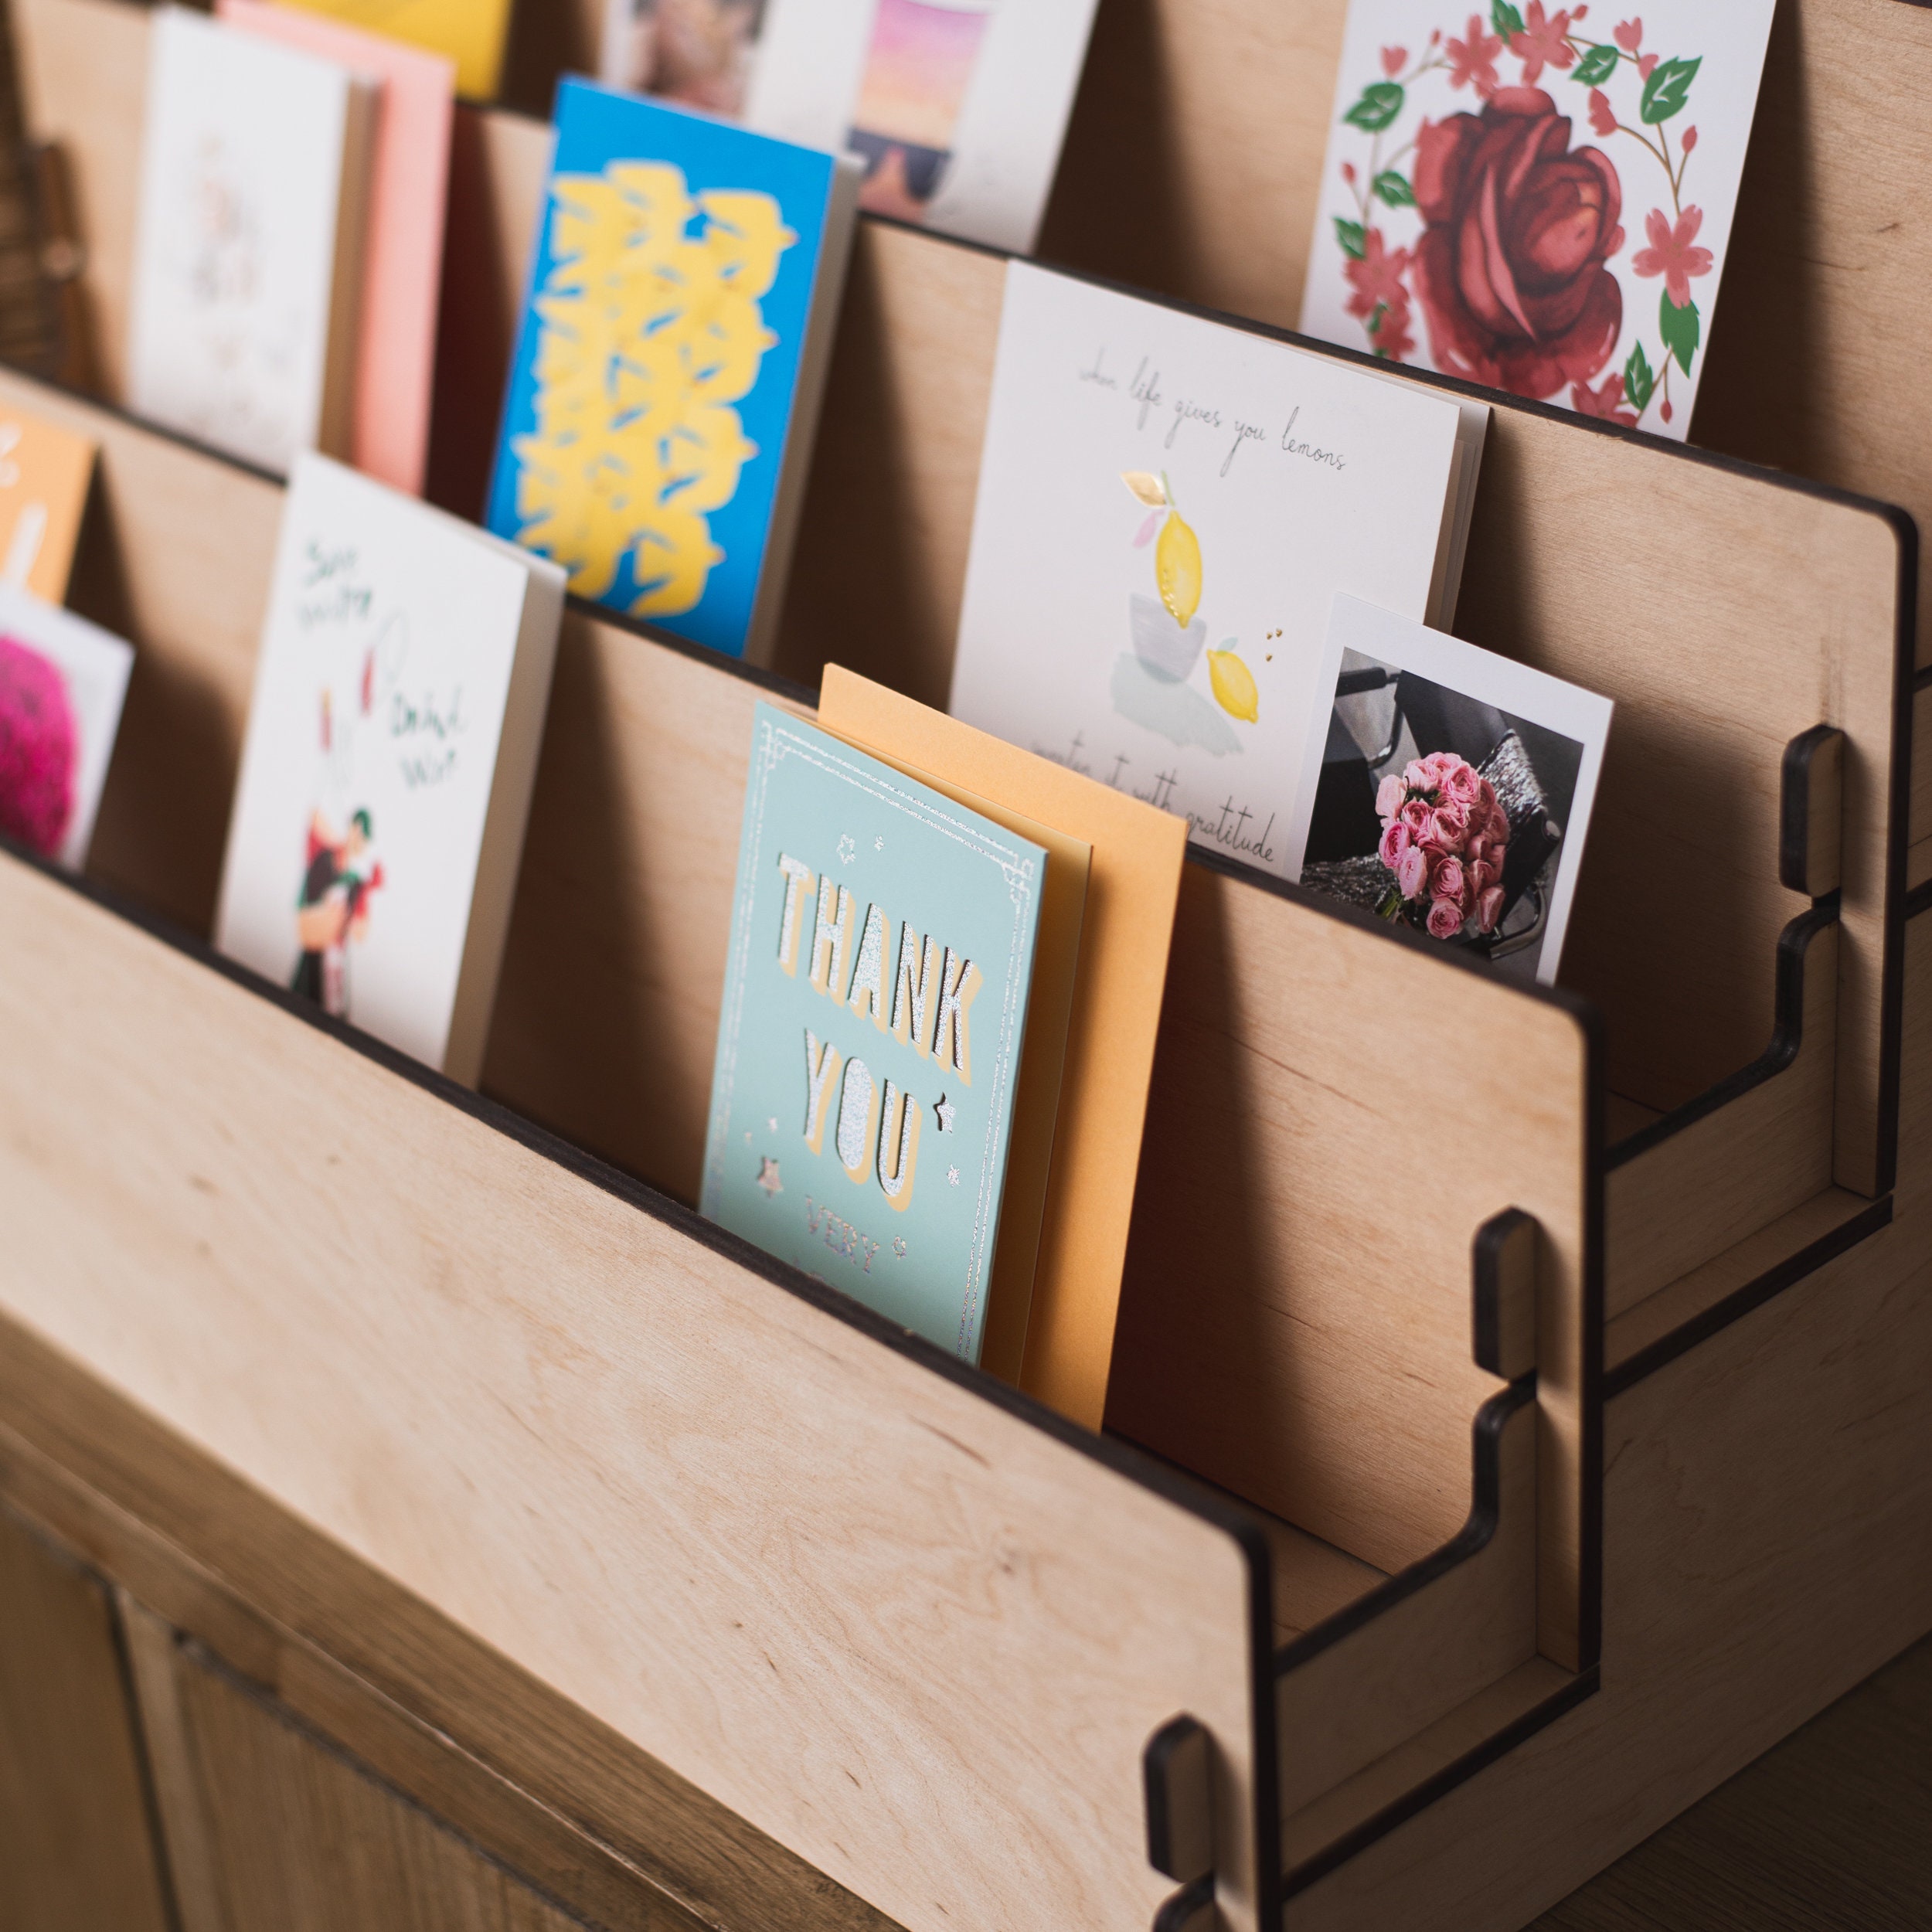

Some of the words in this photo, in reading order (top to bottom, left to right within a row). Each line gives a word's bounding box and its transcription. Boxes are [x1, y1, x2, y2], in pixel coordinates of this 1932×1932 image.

[1128, 355, 1162, 430] life
[1164, 400, 1223, 449] gives
[1219, 418, 1267, 477] you
[1281, 406, 1346, 471] lemons
[1186, 795, 1274, 862] gratitude
[777, 852, 982, 1086] THANK
[804, 1029, 922, 1211] YOU
[804, 1195, 881, 1274] VERY
